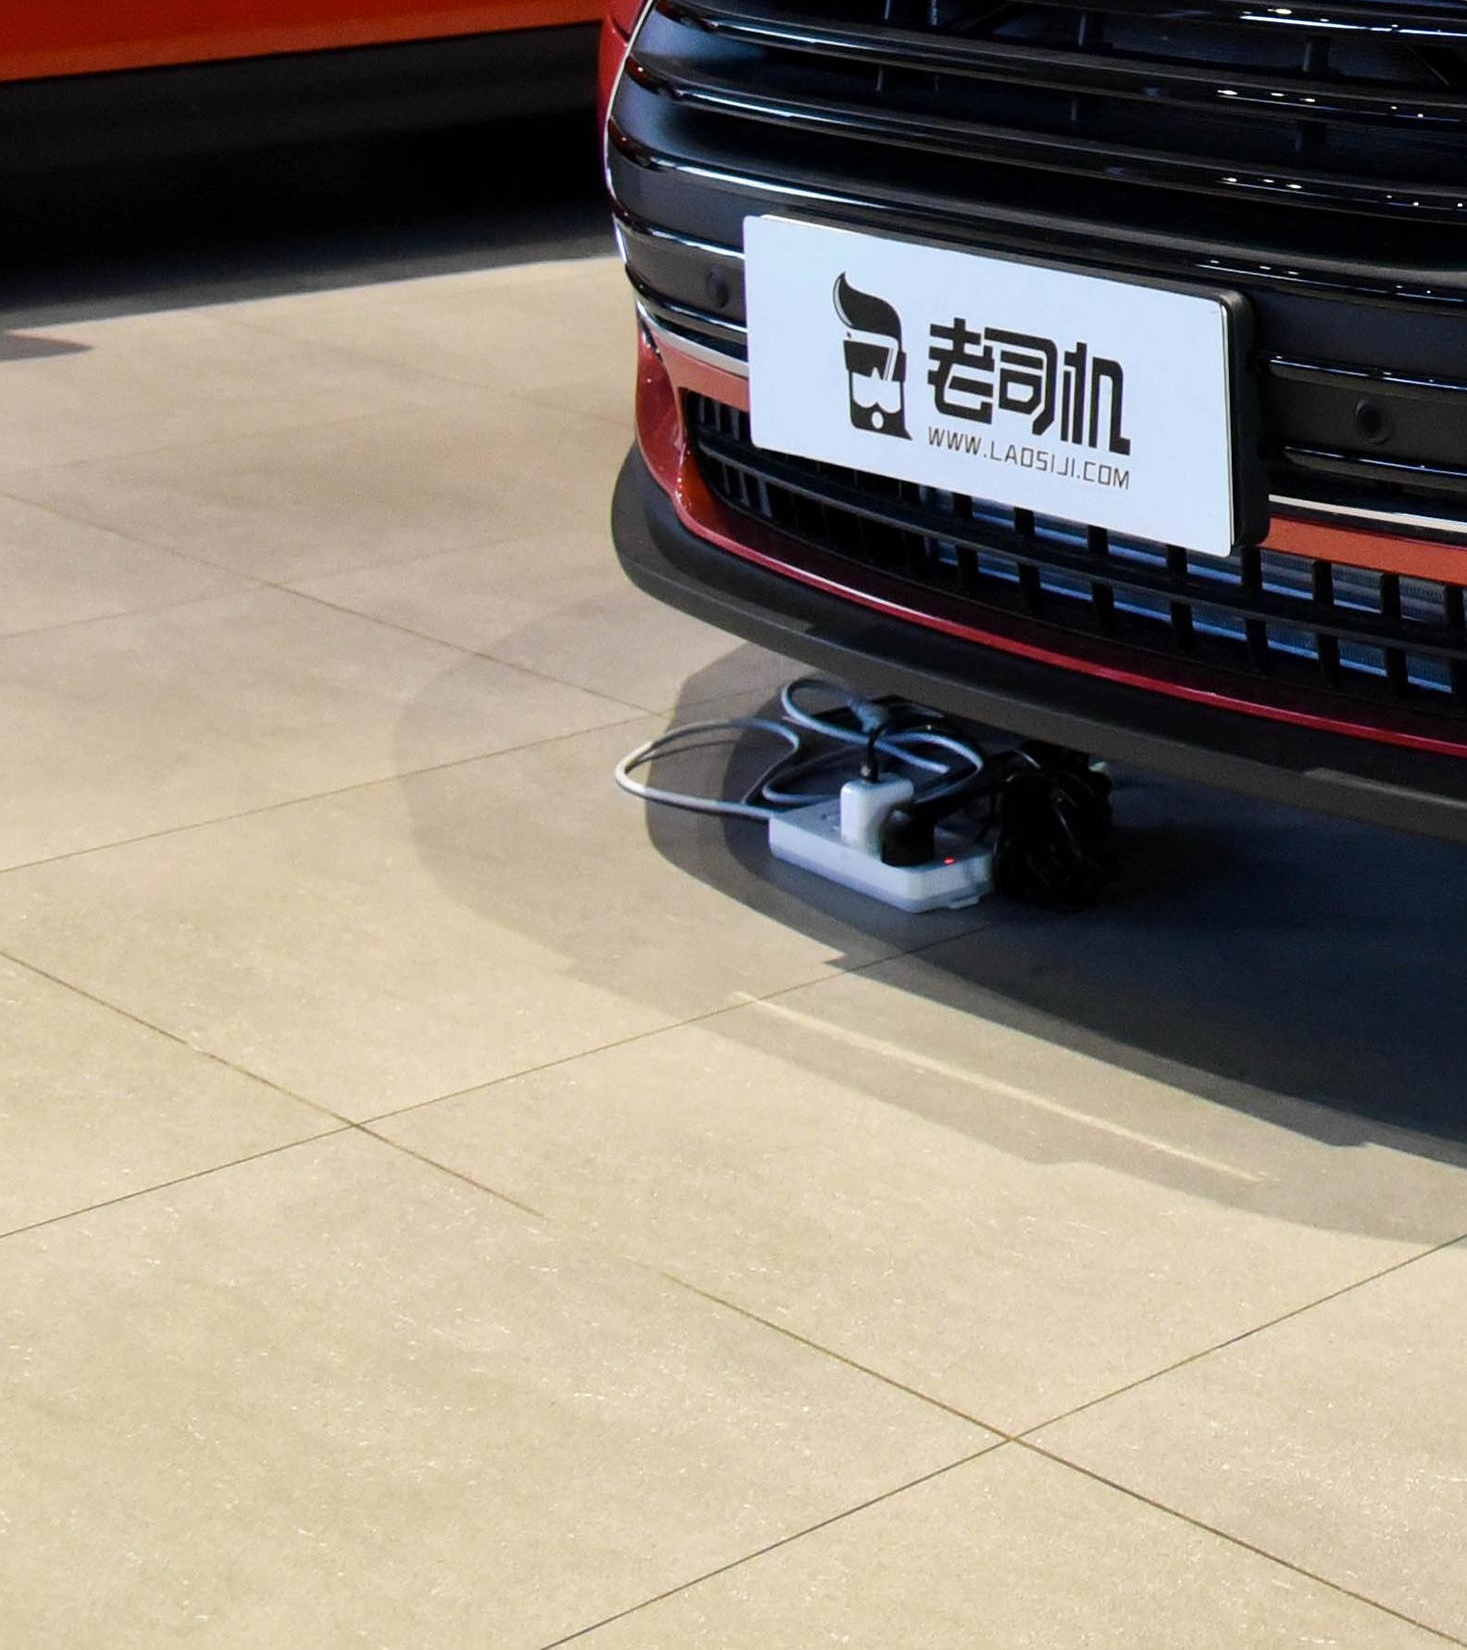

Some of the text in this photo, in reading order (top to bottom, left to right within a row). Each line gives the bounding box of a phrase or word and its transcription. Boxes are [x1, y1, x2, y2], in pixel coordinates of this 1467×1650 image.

[927, 317, 1131, 457] 老司机
[928, 426, 1131, 491] WWW.LAOSIJI.COM
